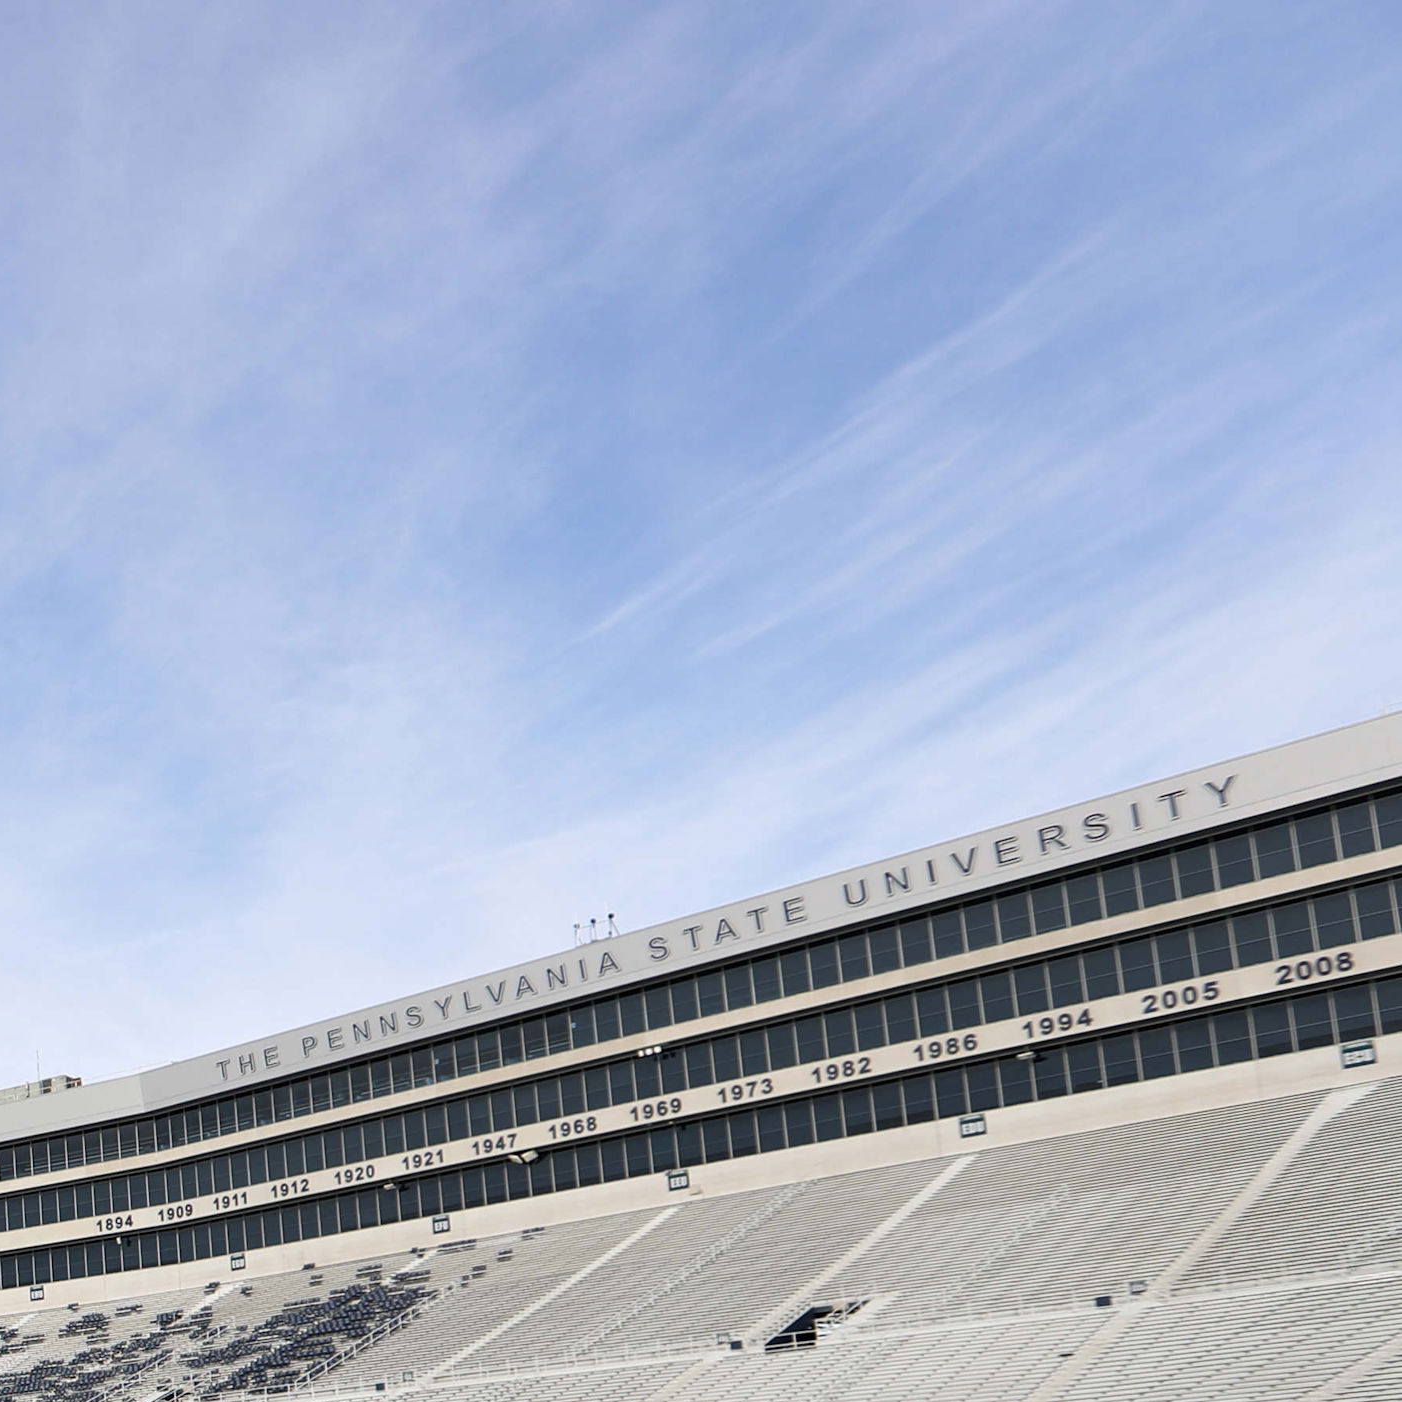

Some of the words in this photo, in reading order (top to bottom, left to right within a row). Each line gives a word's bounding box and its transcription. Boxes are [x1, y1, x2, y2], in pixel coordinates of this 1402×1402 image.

[215, 1045, 282, 1081] THE
[301, 951, 621, 1058] PENNSYLVANIA
[647, 896, 808, 961] STATE
[843, 775, 1239, 908] UNIVERSITY
[96, 1214, 134, 1233] 1894
[157, 1203, 194, 1222] 1909
[212, 1191, 249, 1211] 1911
[270, 1178, 311, 1199] 1912
[334, 1164, 376, 1185] 1920
[401, 1149, 446, 1172] 1921
[471, 1133, 519, 1157] 1947
[548, 1116, 598, 1140] 1968
[629, 1098, 683, 1123] 1969
[717, 1078, 774, 1104] 1973
[811, 1056, 872, 1084] 1982
[913, 1033, 979, 1063] 1986
[1022, 1007, 1095, 1039] 1994
[1142, 981, 1221, 1015] 2005
[1274, 951, 1356, 987] 2008
